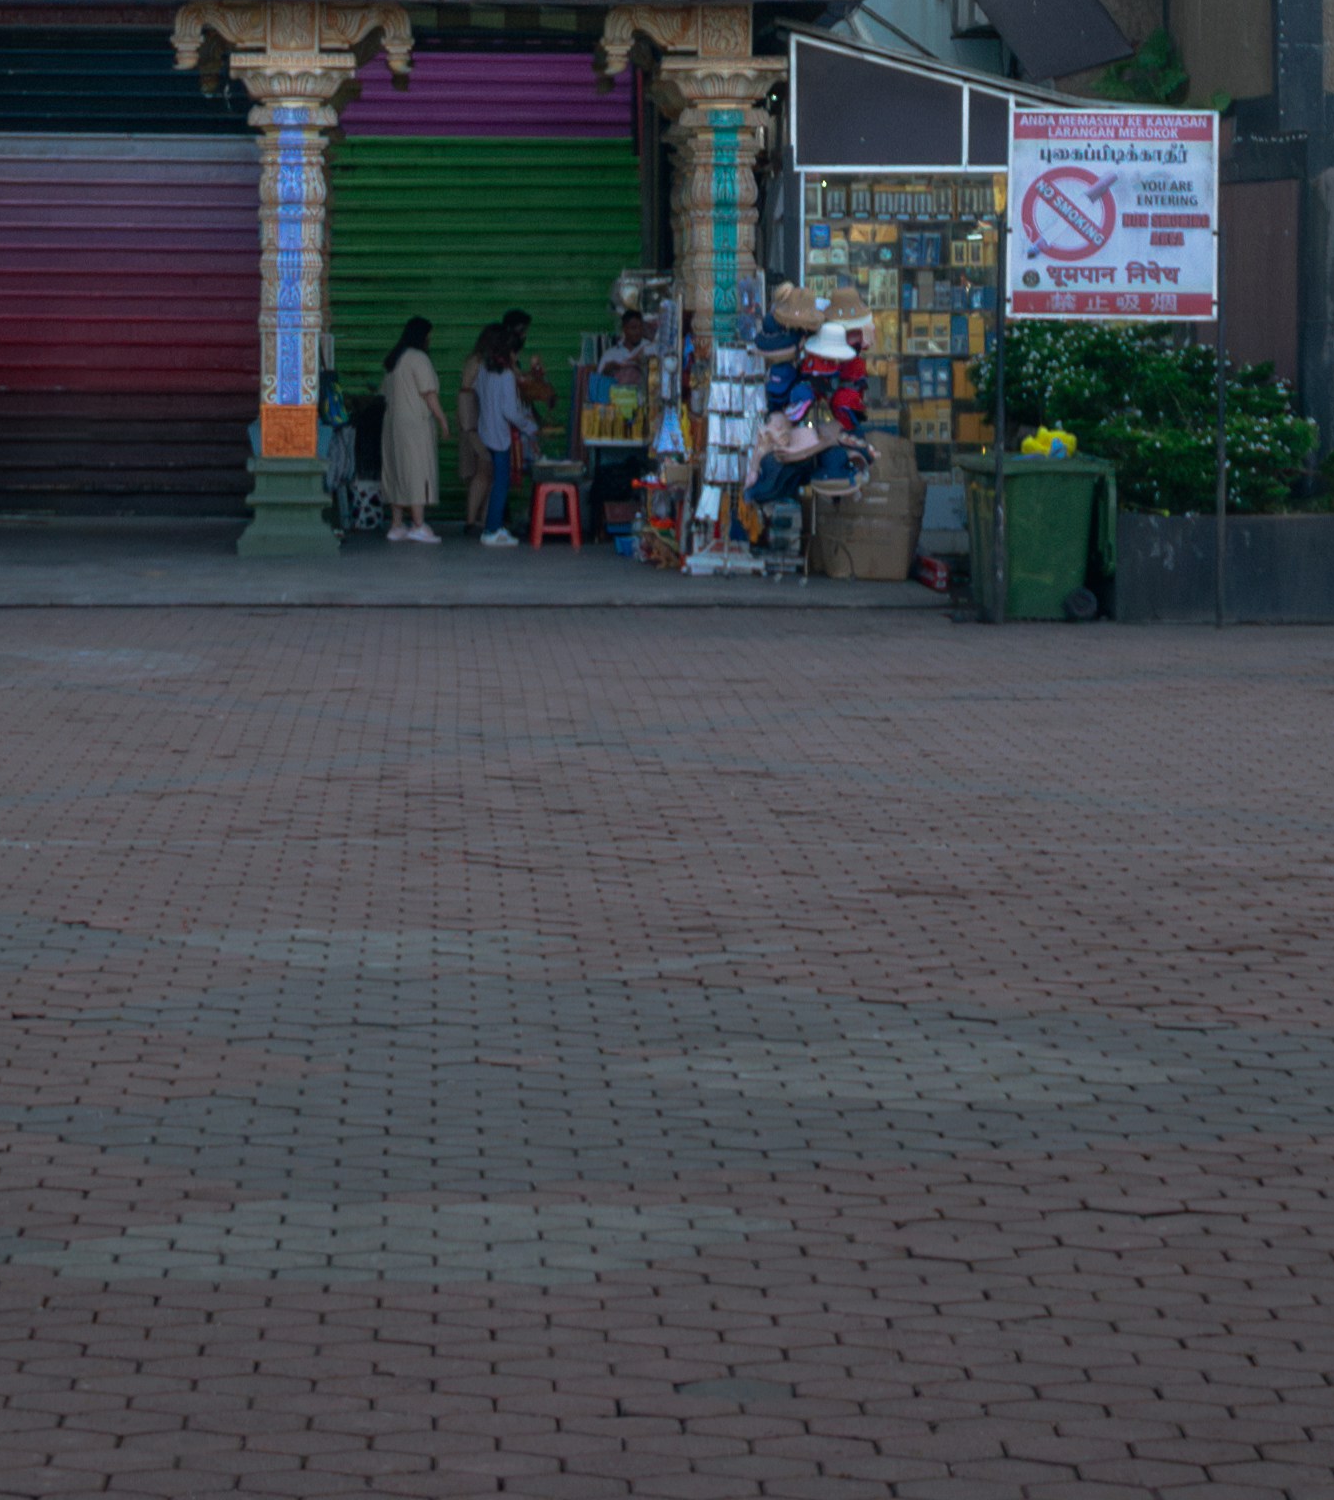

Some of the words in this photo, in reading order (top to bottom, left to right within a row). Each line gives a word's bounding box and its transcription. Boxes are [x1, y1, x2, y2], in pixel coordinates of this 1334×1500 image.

[1020, 115, 1055, 125] ANDA
[1058, 116, 1124, 126] MEMASUKI
[1128, 117, 1142, 126] KE
[1146, 118, 1207, 128] KAWASAN
[1048, 127, 1115, 138] LARANGAN
[1119, 128, 1178, 138] MEROKOK
[1141, 180, 1165, 192] YOU
[1169, 180, 1193, 192] ARE
[1136, 194, 1198, 206] ENTERING
[1035, 180, 1055, 199] NO
[1054, 197, 1105, 246] SMOKING
